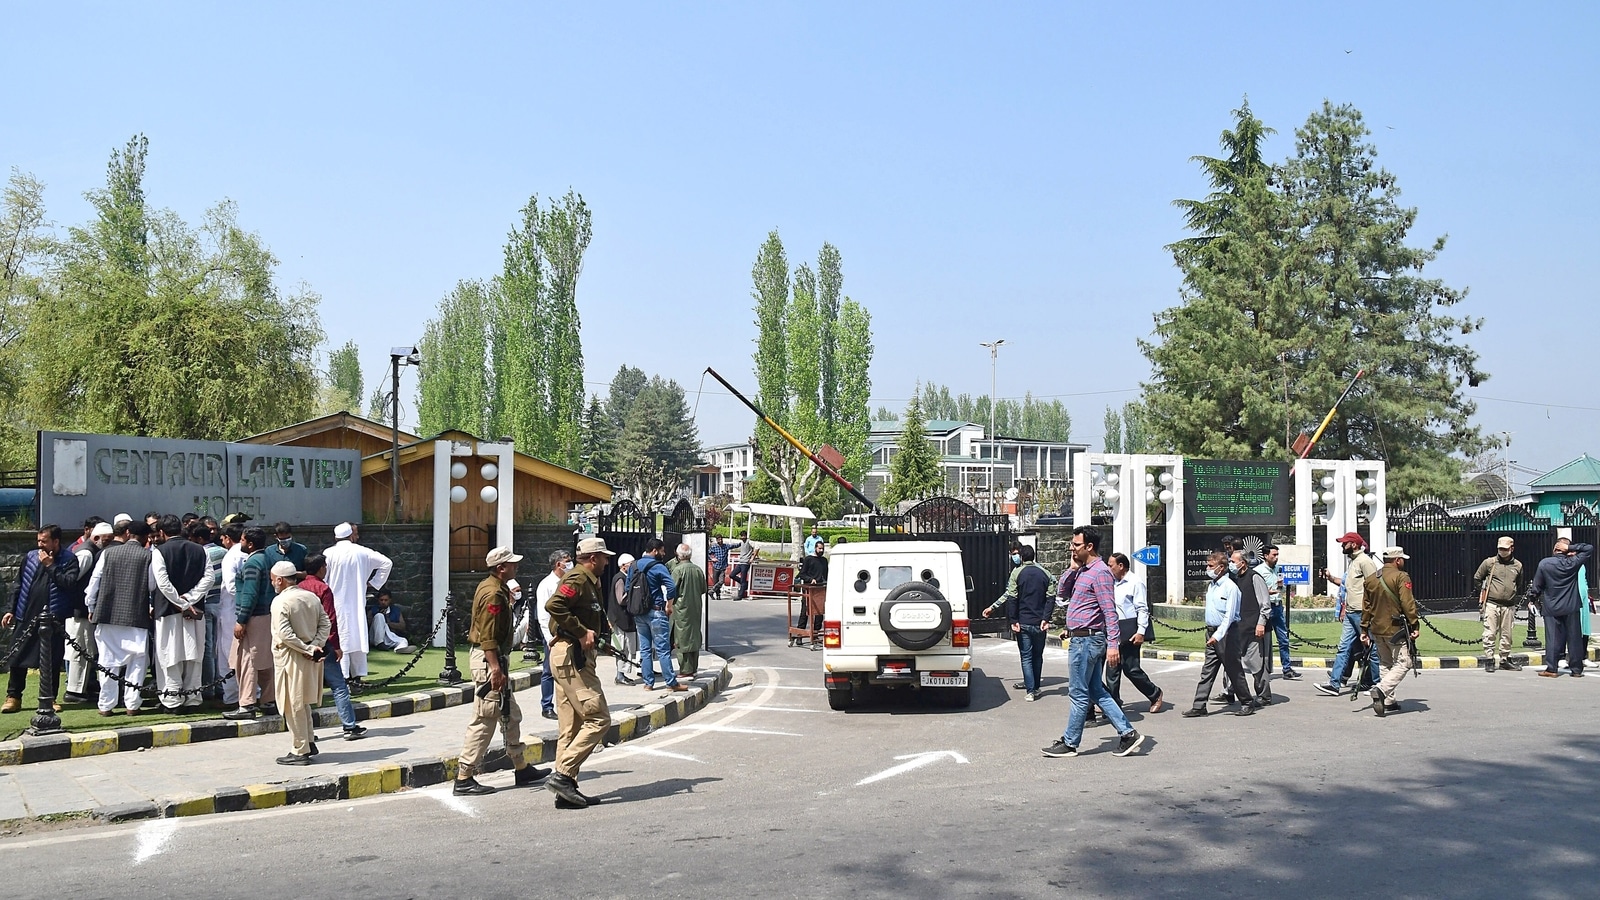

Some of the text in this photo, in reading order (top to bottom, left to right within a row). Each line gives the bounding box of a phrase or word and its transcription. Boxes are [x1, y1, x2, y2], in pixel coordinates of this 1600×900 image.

[94, 448, 353, 490] CENTAUR LAKE VIEW
[1233, 466, 1242, 475] to
[1267, 467, 1279, 476] PM
[194, 494, 266, 520] HOTEL
[1146, 552, 1156, 560] IN
[1187, 548, 1213, 556] Kashmir
[1187, 569, 1207, 577] Confer
